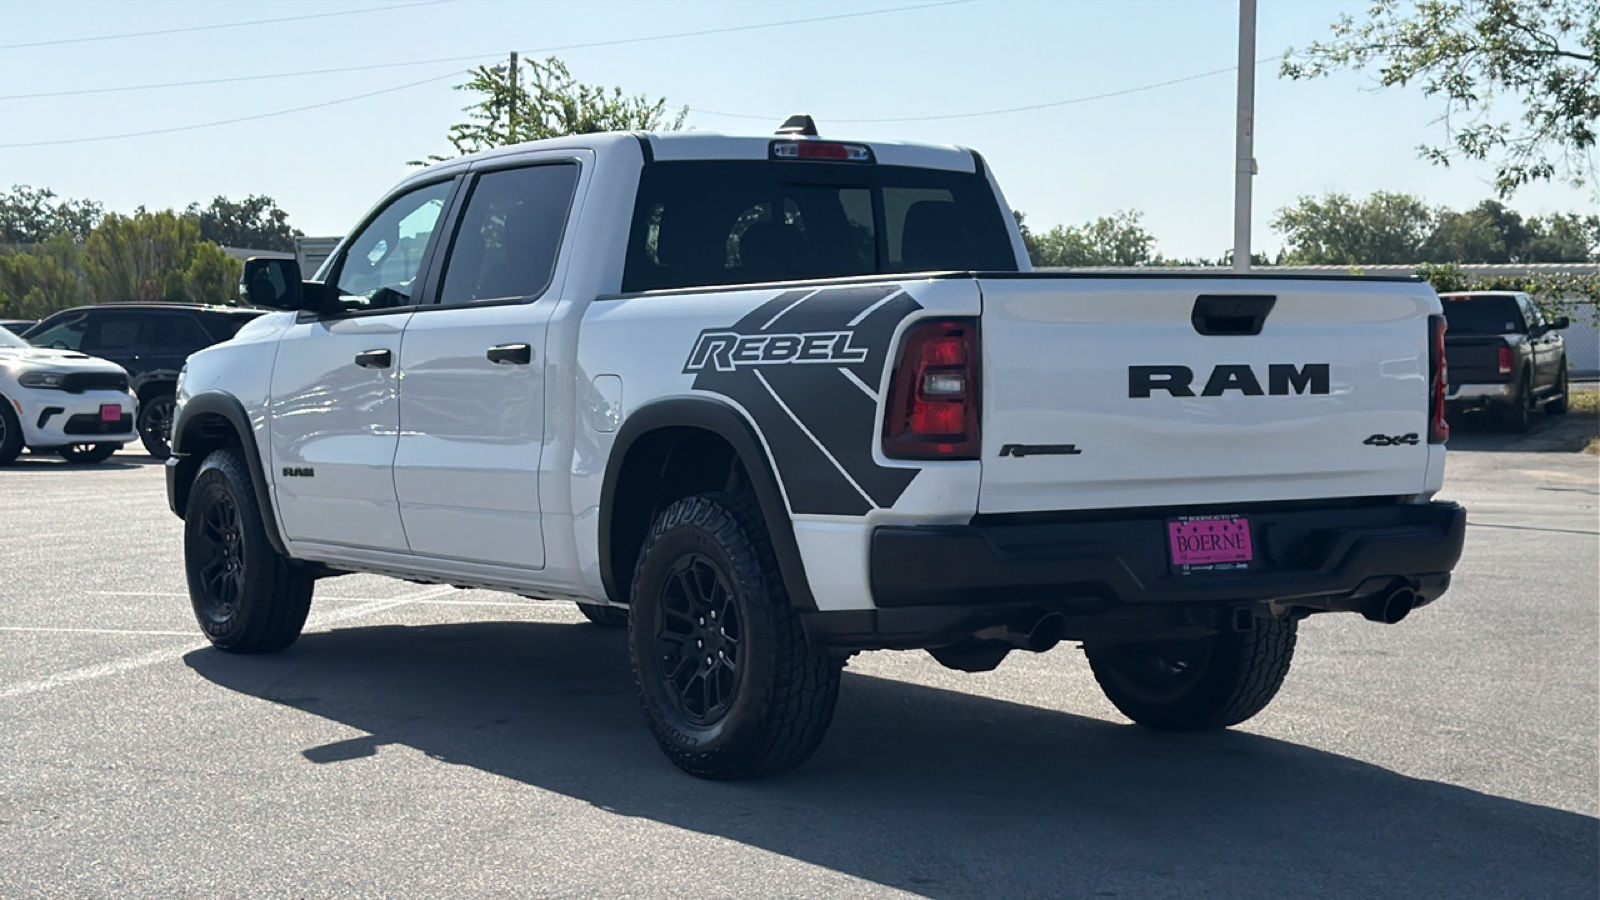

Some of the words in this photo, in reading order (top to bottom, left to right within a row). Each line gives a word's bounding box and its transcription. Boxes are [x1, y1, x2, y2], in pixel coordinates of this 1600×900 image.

[686, 330, 869, 372] REBEL
[1128, 364, 1330, 398] RAM
[1362, 432, 1421, 446] 4x4
[282, 467, 315, 477] RAM
[1176, 531, 1247, 552] BOERNE
